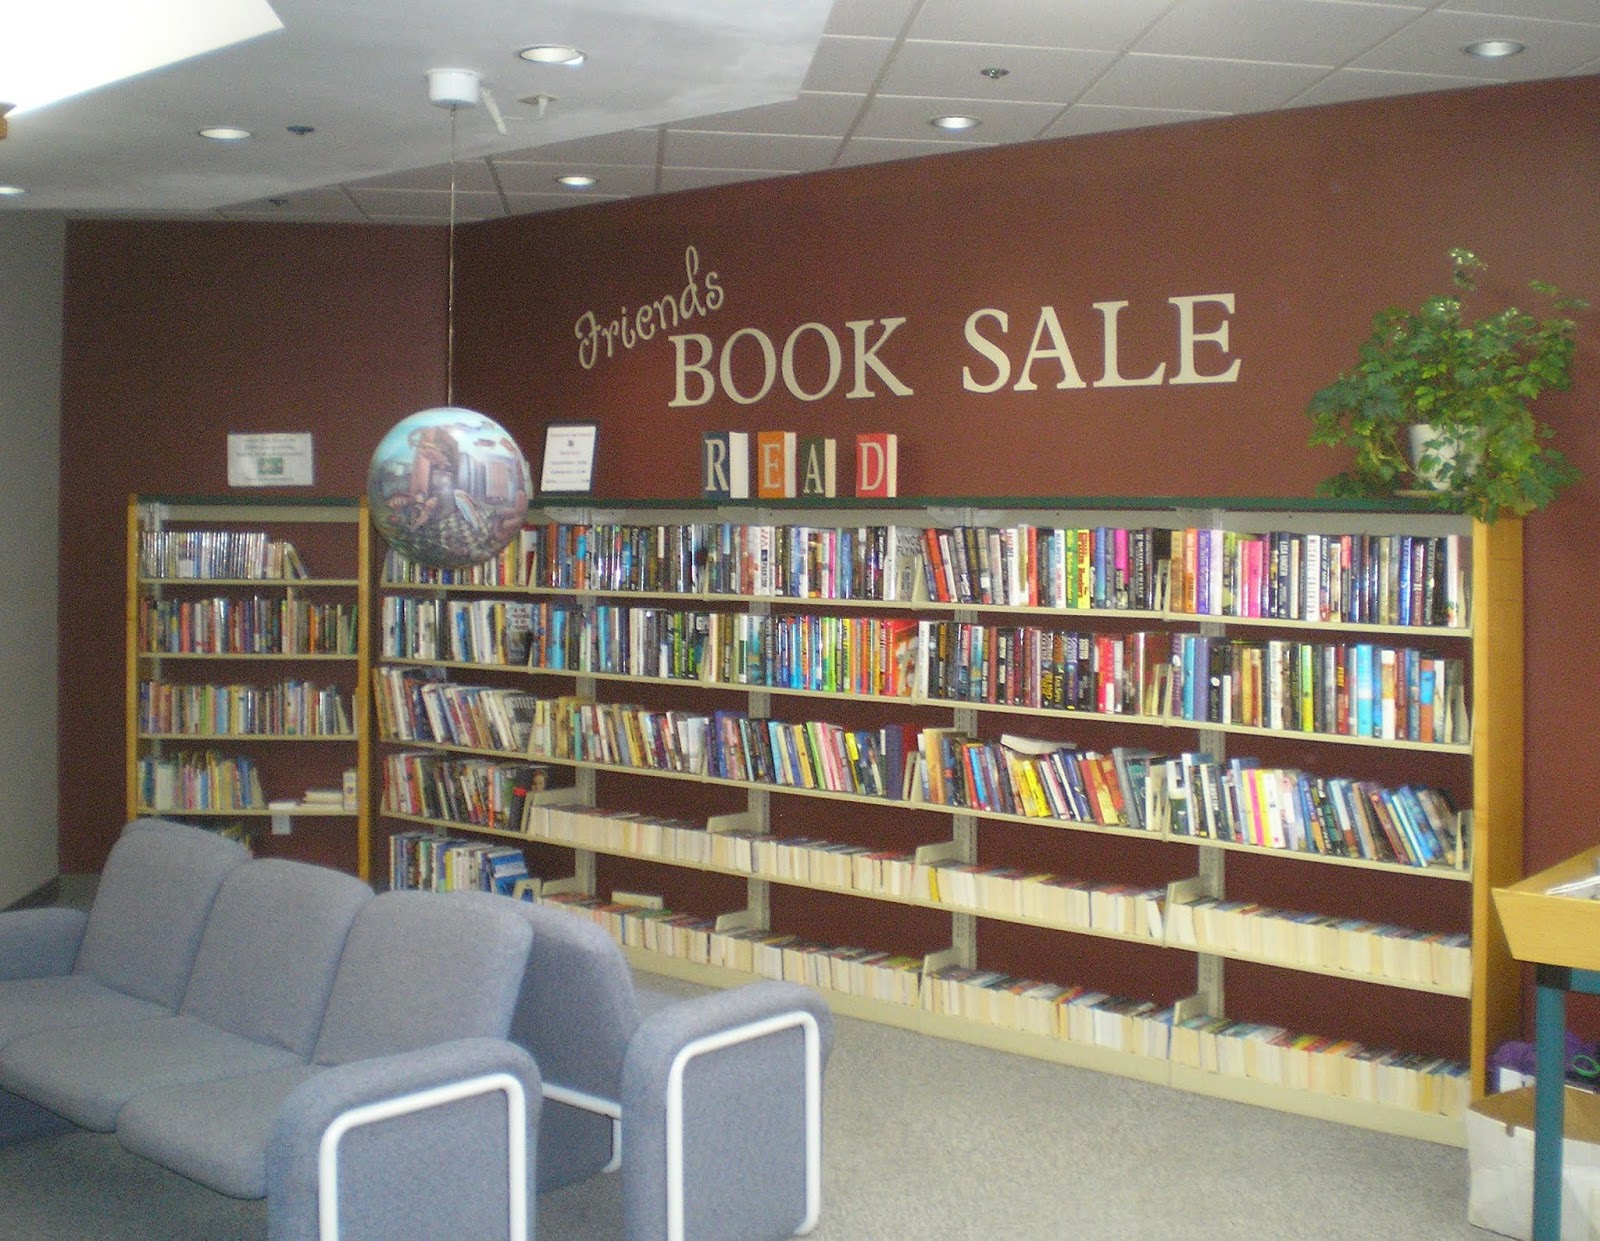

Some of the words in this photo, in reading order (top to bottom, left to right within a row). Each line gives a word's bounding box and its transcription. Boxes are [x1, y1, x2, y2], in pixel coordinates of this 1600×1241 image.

[574, 245, 724, 370] Friends
[667, 316, 914, 408] BOOK
[962, 293, 1242, 394] SALE
